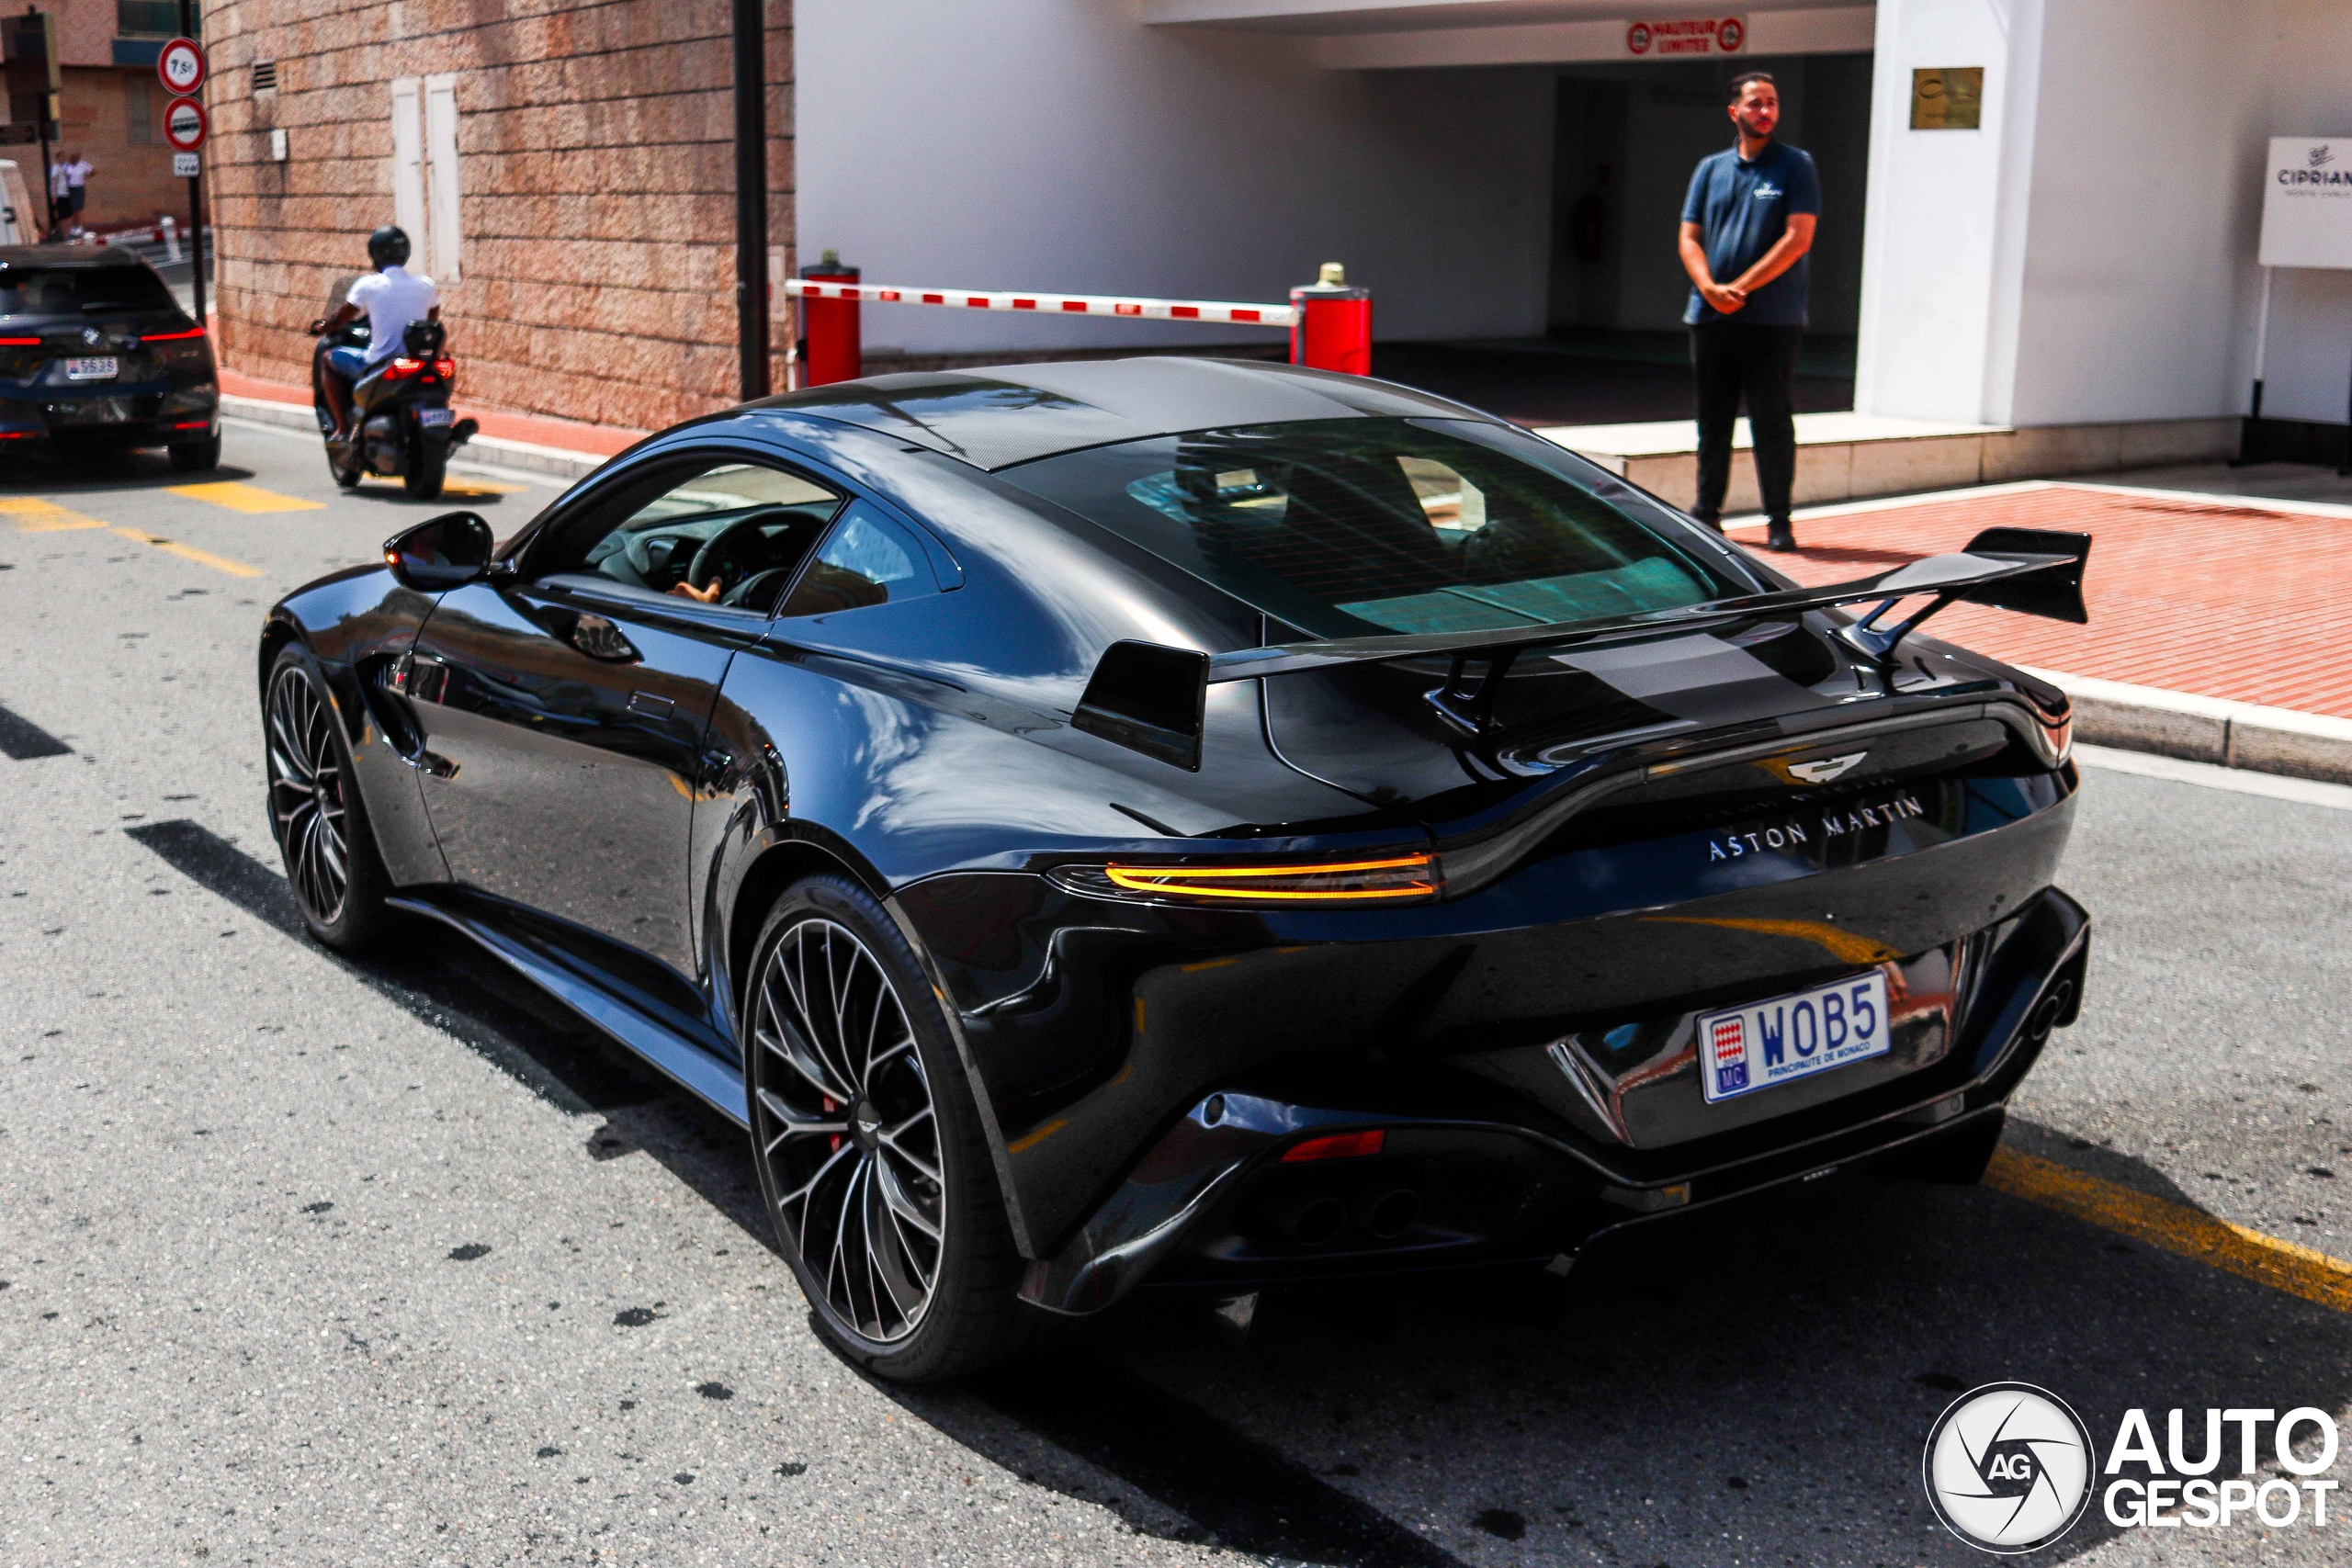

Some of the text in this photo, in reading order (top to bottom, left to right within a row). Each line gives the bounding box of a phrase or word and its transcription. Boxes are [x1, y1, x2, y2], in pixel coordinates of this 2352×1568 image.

[1653, 20, 1716, 35] HAUTEUR
[1710, 795, 1924, 862] ASTON MARTIN
[1824, 1051, 1836, 1063] DE
[1838, 1040, 1871, 1058] MONACO
[1722, 1066, 1744, 1089] MC
